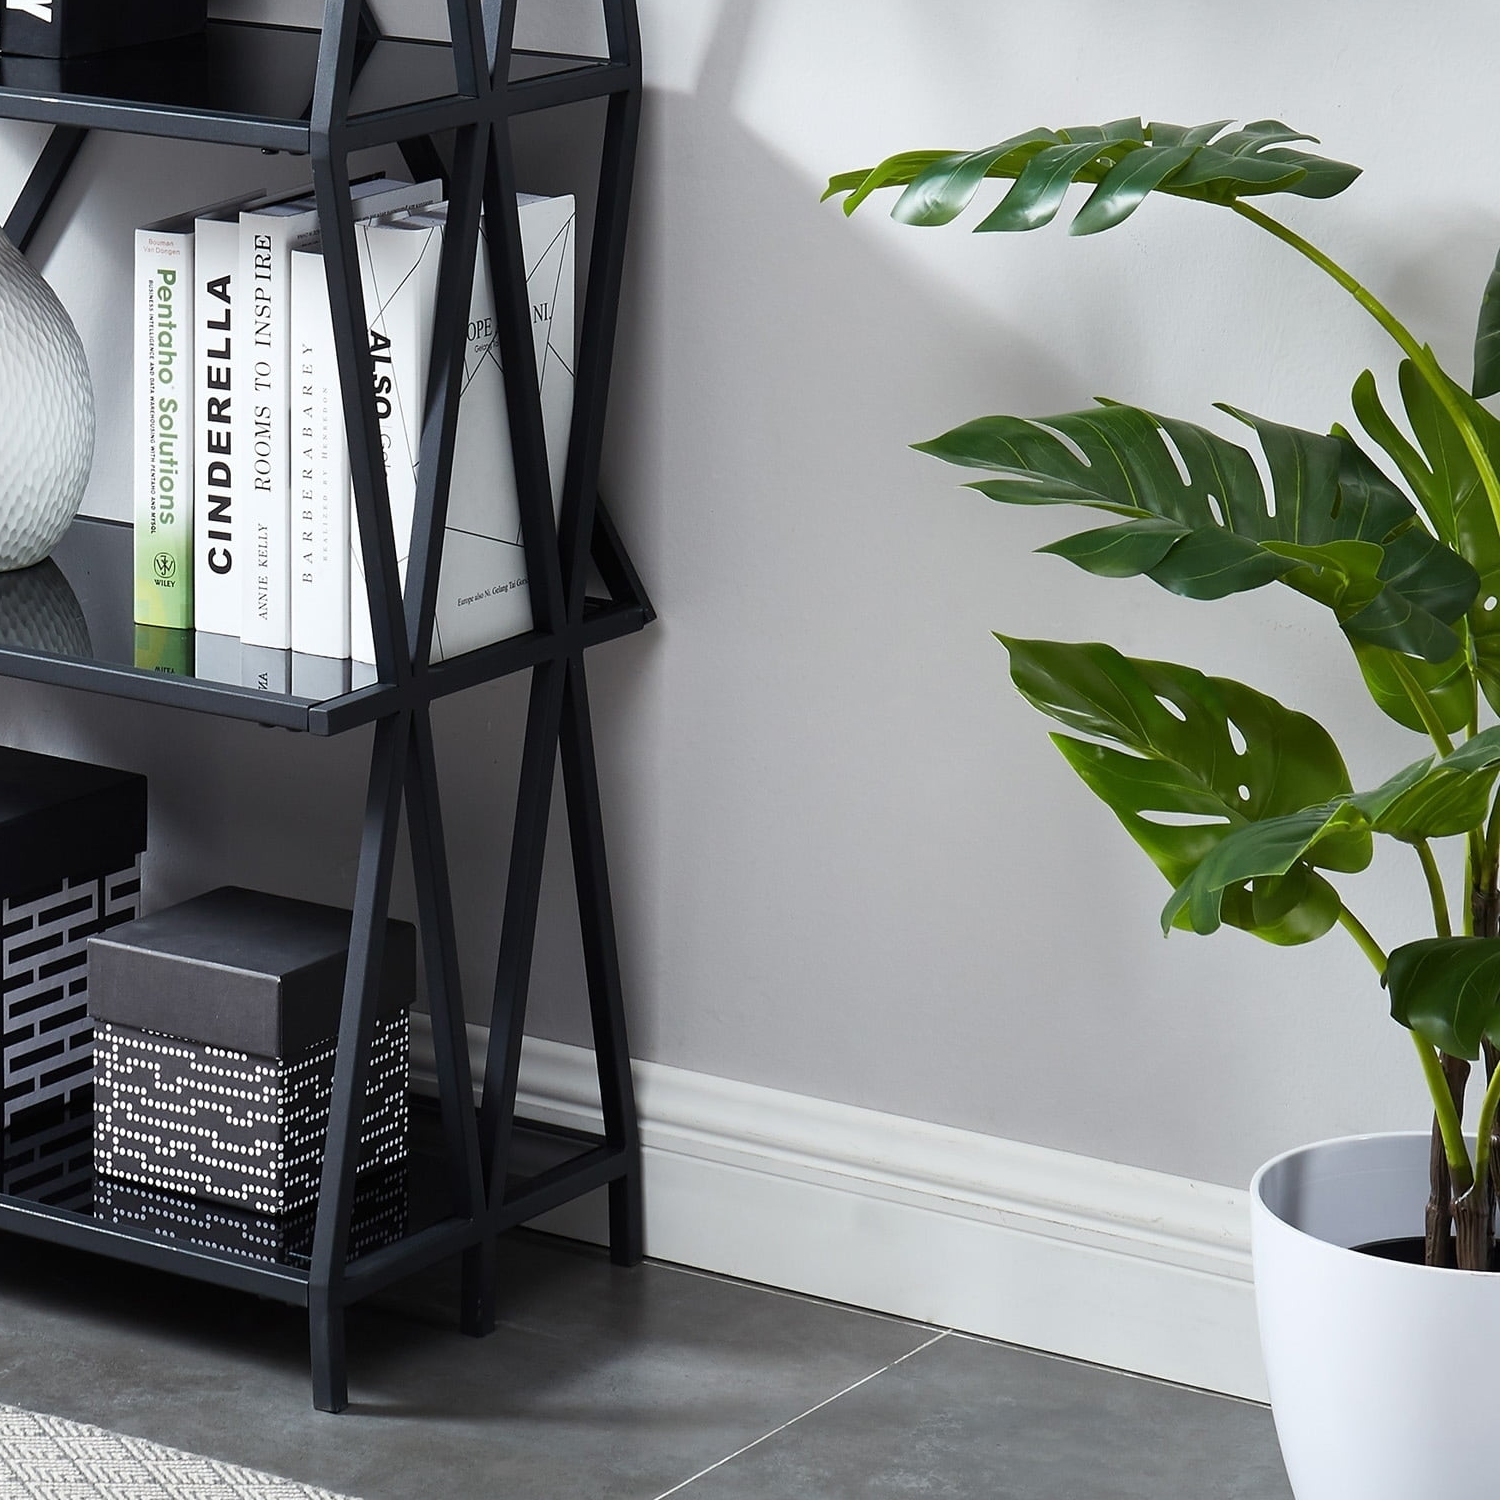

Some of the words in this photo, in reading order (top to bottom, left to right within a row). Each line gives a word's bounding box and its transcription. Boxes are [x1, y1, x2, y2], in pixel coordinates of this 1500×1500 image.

[143, 246, 155, 254] Van
[155, 246, 181, 256] Dongen
[148, 238, 174, 247] Bouman
[157, 269, 177, 385] Pentaho
[467, 317, 493, 342] OPE
[255, 361, 271, 392] TO
[207, 275, 232, 575] CINDERELLA
[158, 397, 178, 525] Solutions
[254, 406, 271, 492] ROOMS
[322, 471, 329, 485] BY
[258, 523, 268, 567] KELLY
[154, 579, 176, 588] WILEY
[258, 575, 268, 620] ANNIE
[457, 596, 474, 607] Europe
